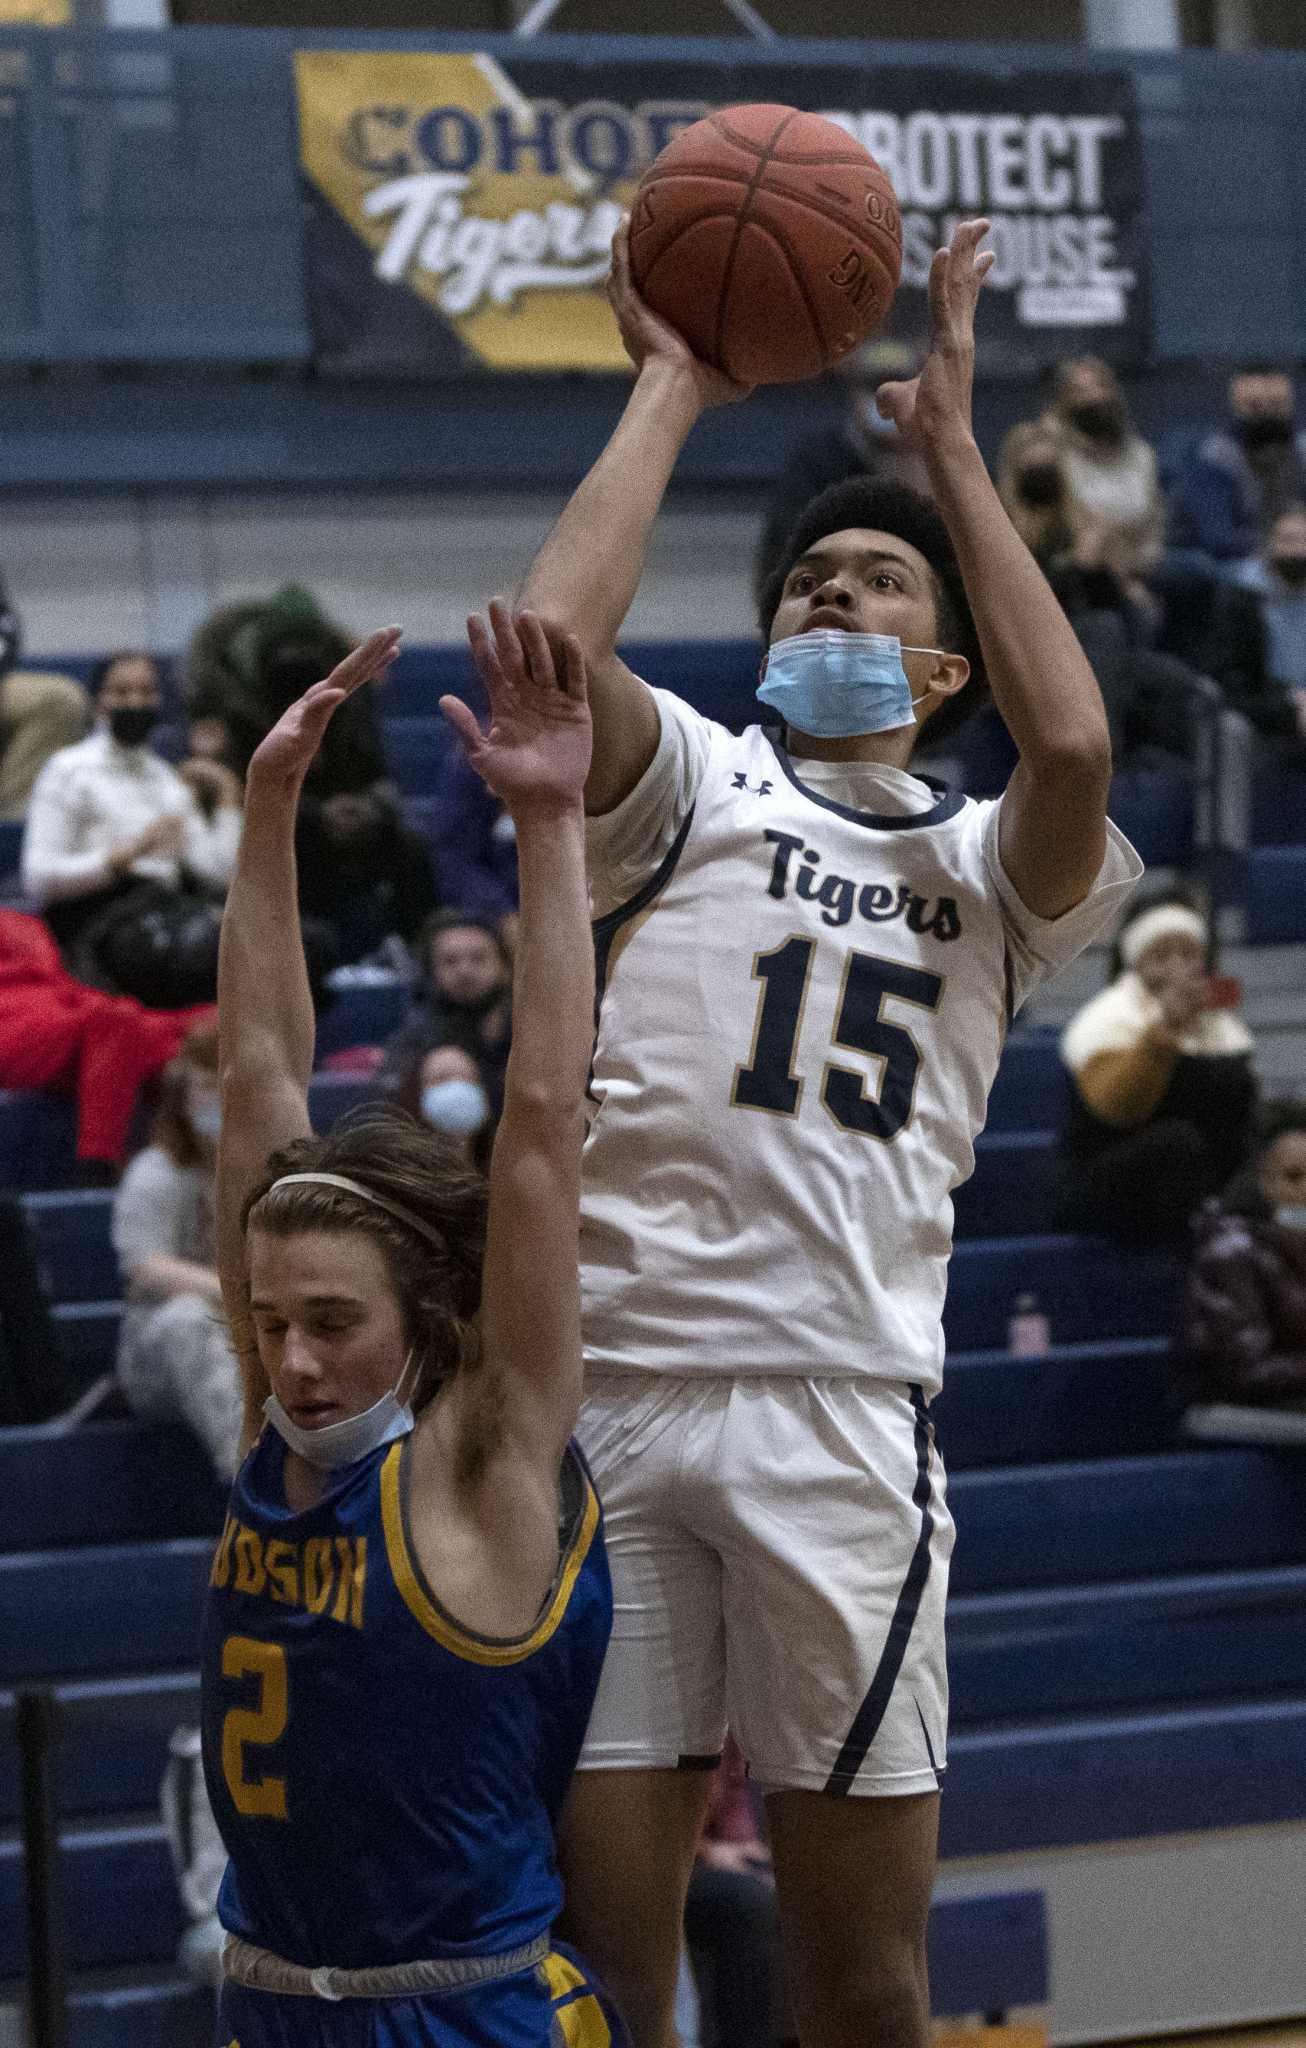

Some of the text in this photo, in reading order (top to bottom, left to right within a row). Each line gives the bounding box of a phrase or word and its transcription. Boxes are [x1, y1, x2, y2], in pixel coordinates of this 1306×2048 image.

[343, 101, 714, 180] COHO
[943, 213, 1136, 288] OUSE
[764, 829, 961, 942] Tigers
[730, 933, 947, 1144] 15
[209, 1514, 368, 1630] UDSON
[221, 1636, 288, 1819] 2
